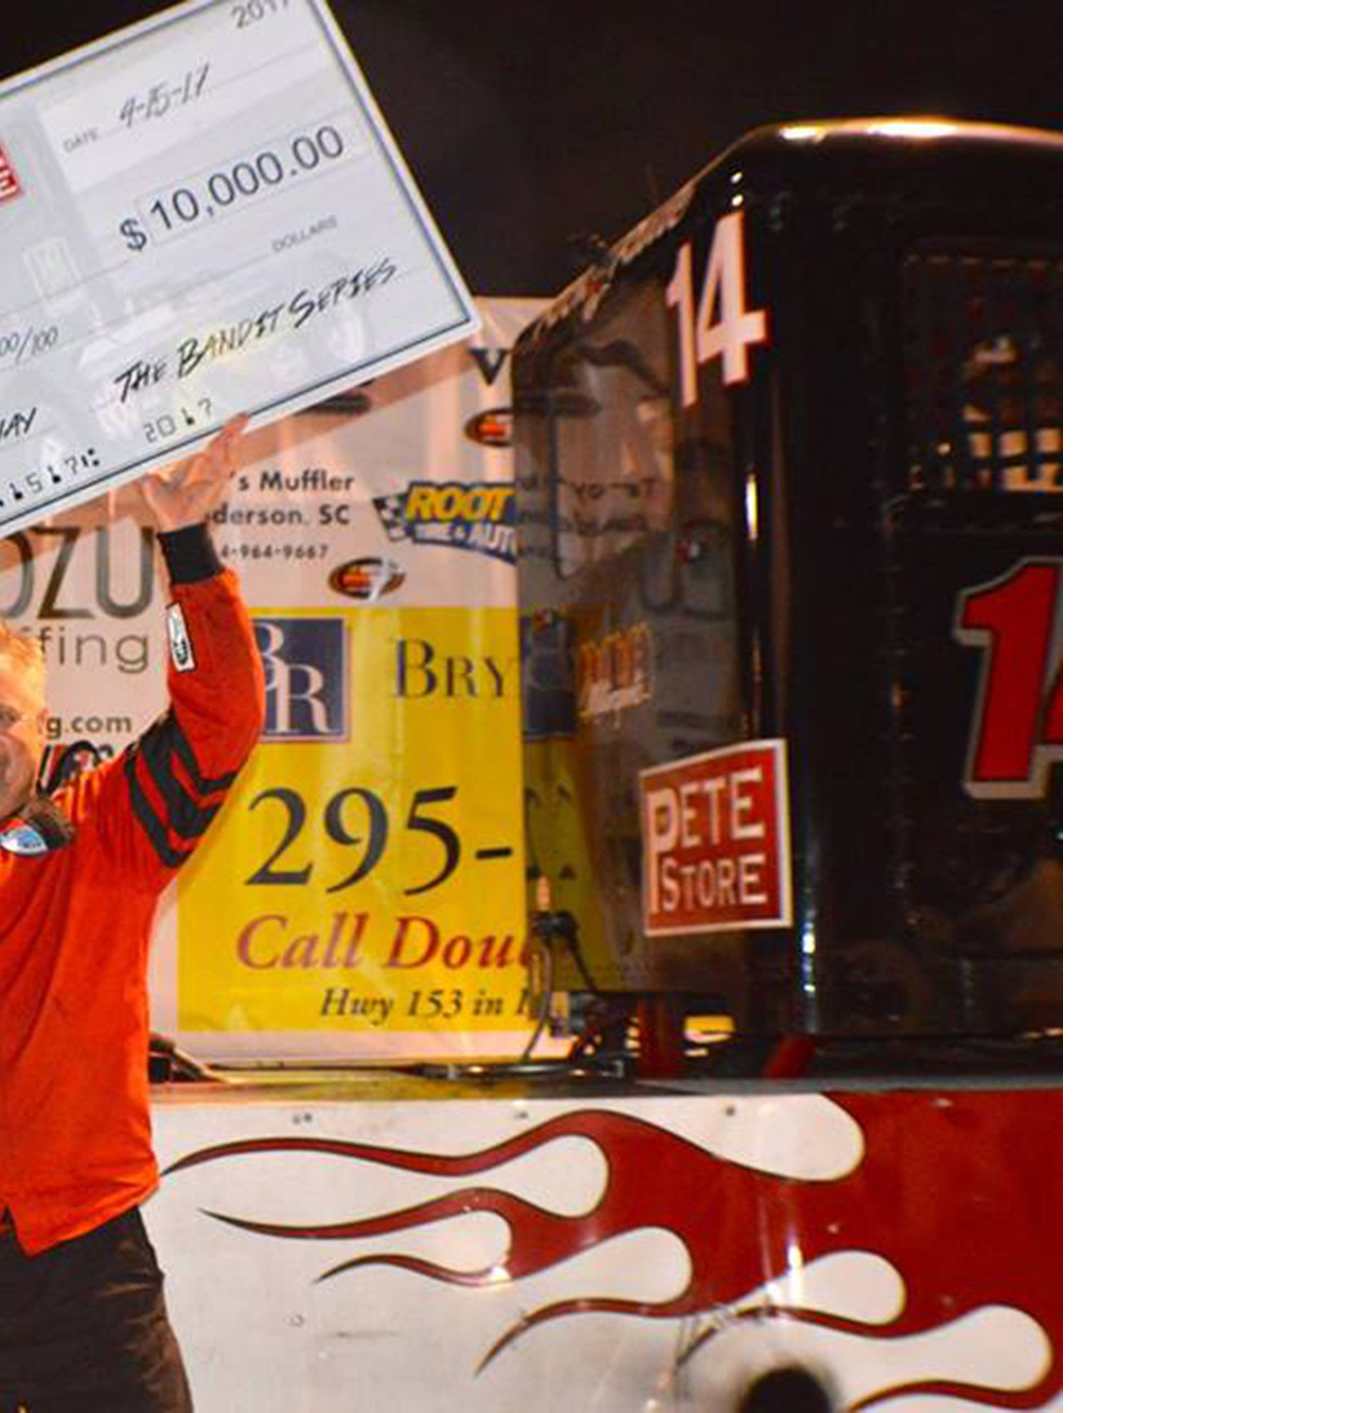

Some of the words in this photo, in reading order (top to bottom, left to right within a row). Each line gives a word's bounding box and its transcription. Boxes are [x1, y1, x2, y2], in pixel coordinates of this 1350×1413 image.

[271, 215, 338, 252] DOLLARS
[113, 360, 167, 403] THE
[176, 304, 285, 378] BANDIT
[288, 257, 398, 328] SERIES
[665, 210, 769, 409] 14
[259, 468, 355, 492] Muffler
[318, 503, 351, 526] SC
[646, 766, 765, 914] PETE
[661, 853, 769, 912] STORE
[236, 912, 370, 970] Call
[320, 987, 394, 1019] Hwy
[407, 989, 463, 1017] 153
[473, 989, 504, 1016] in
